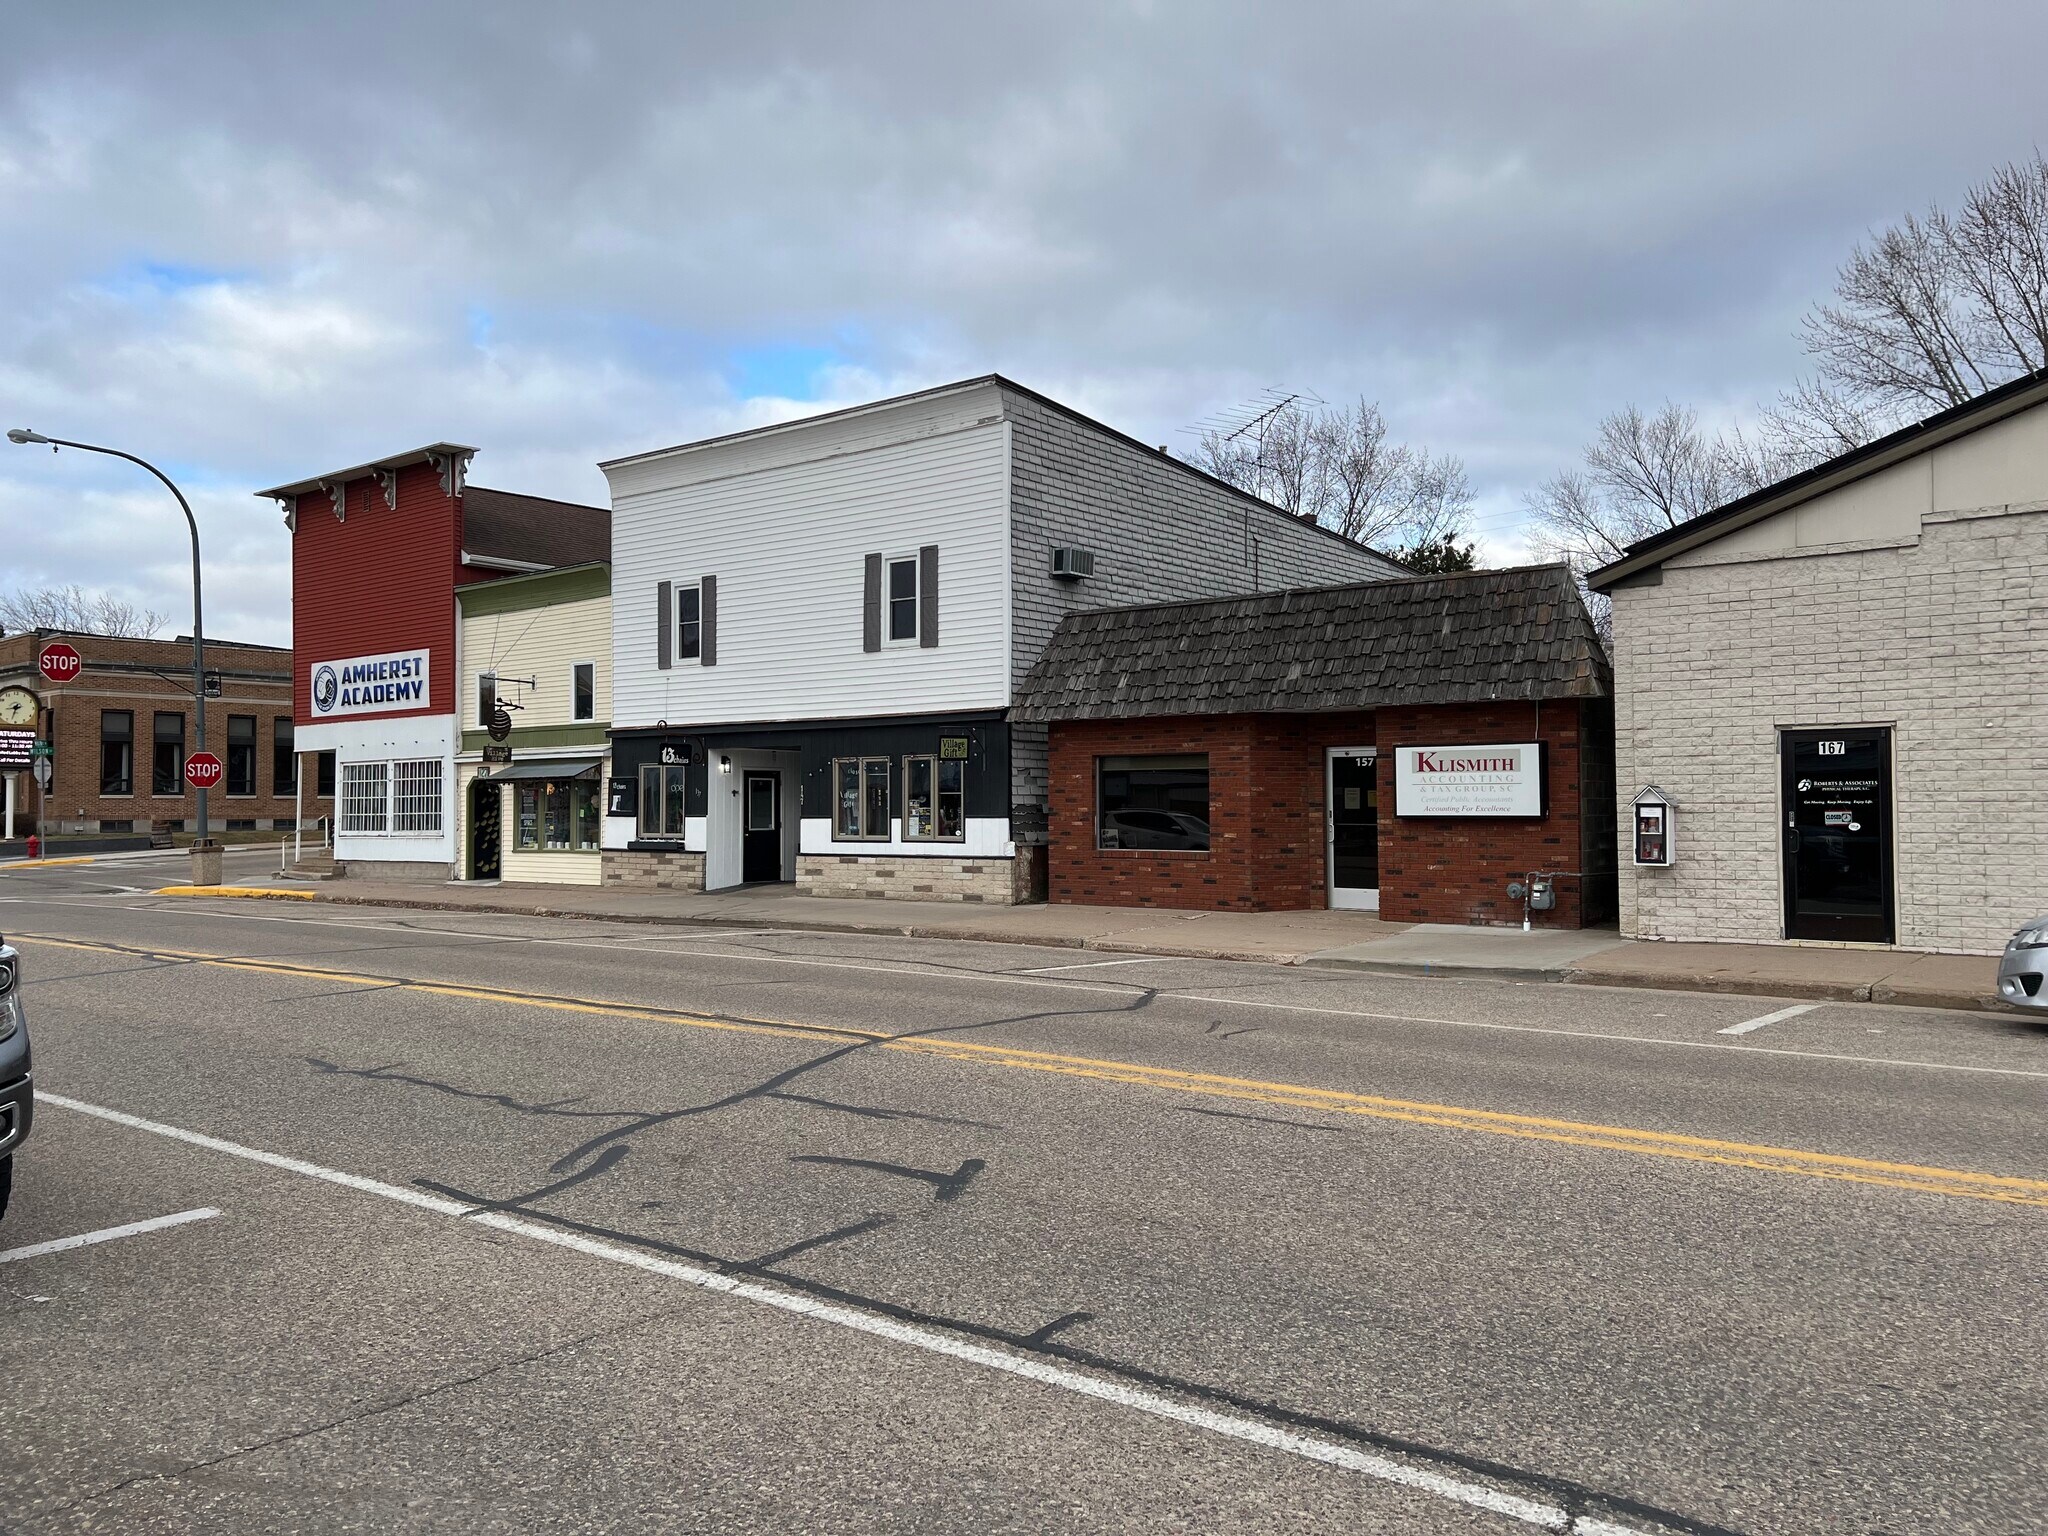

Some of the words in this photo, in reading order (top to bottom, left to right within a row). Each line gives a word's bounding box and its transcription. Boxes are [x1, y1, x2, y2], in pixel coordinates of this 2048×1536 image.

[42, 655, 79, 670] STOP
[341, 657, 422, 684] AMHERST
[341, 680, 423, 706] ACADEMY
[942, 739, 965, 751] Village
[1820, 742, 1844, 754] 167
[661, 747, 675, 763] 13
[674, 755, 689, 763] chairs
[944, 748, 958, 757] Gift
[1356, 757, 1374, 767] 157
[1416, 752, 1514, 772] KLISMITH
[187, 764, 220, 777] STOP
[1421, 775, 1514, 783] ACCOUNTING
[1424, 805, 1460, 813] Accounting
